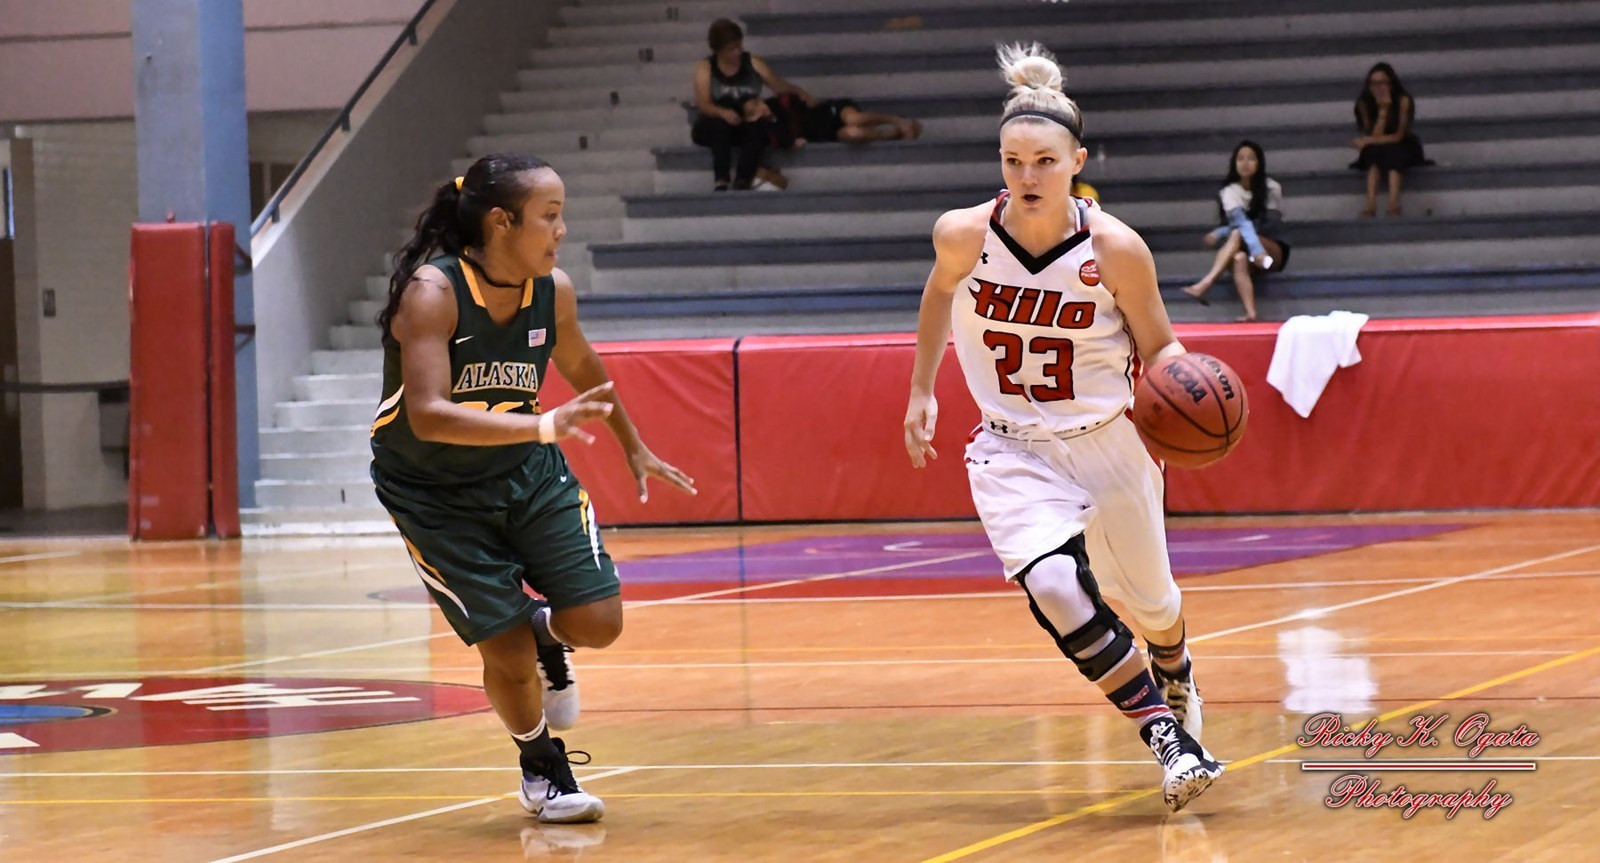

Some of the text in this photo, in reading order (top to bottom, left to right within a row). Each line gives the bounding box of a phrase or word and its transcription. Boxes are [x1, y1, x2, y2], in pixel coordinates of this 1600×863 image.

[452, 361, 538, 393] ALASKA
[983, 329, 1075, 402] 23
[1163, 361, 1208, 404] NCAA
